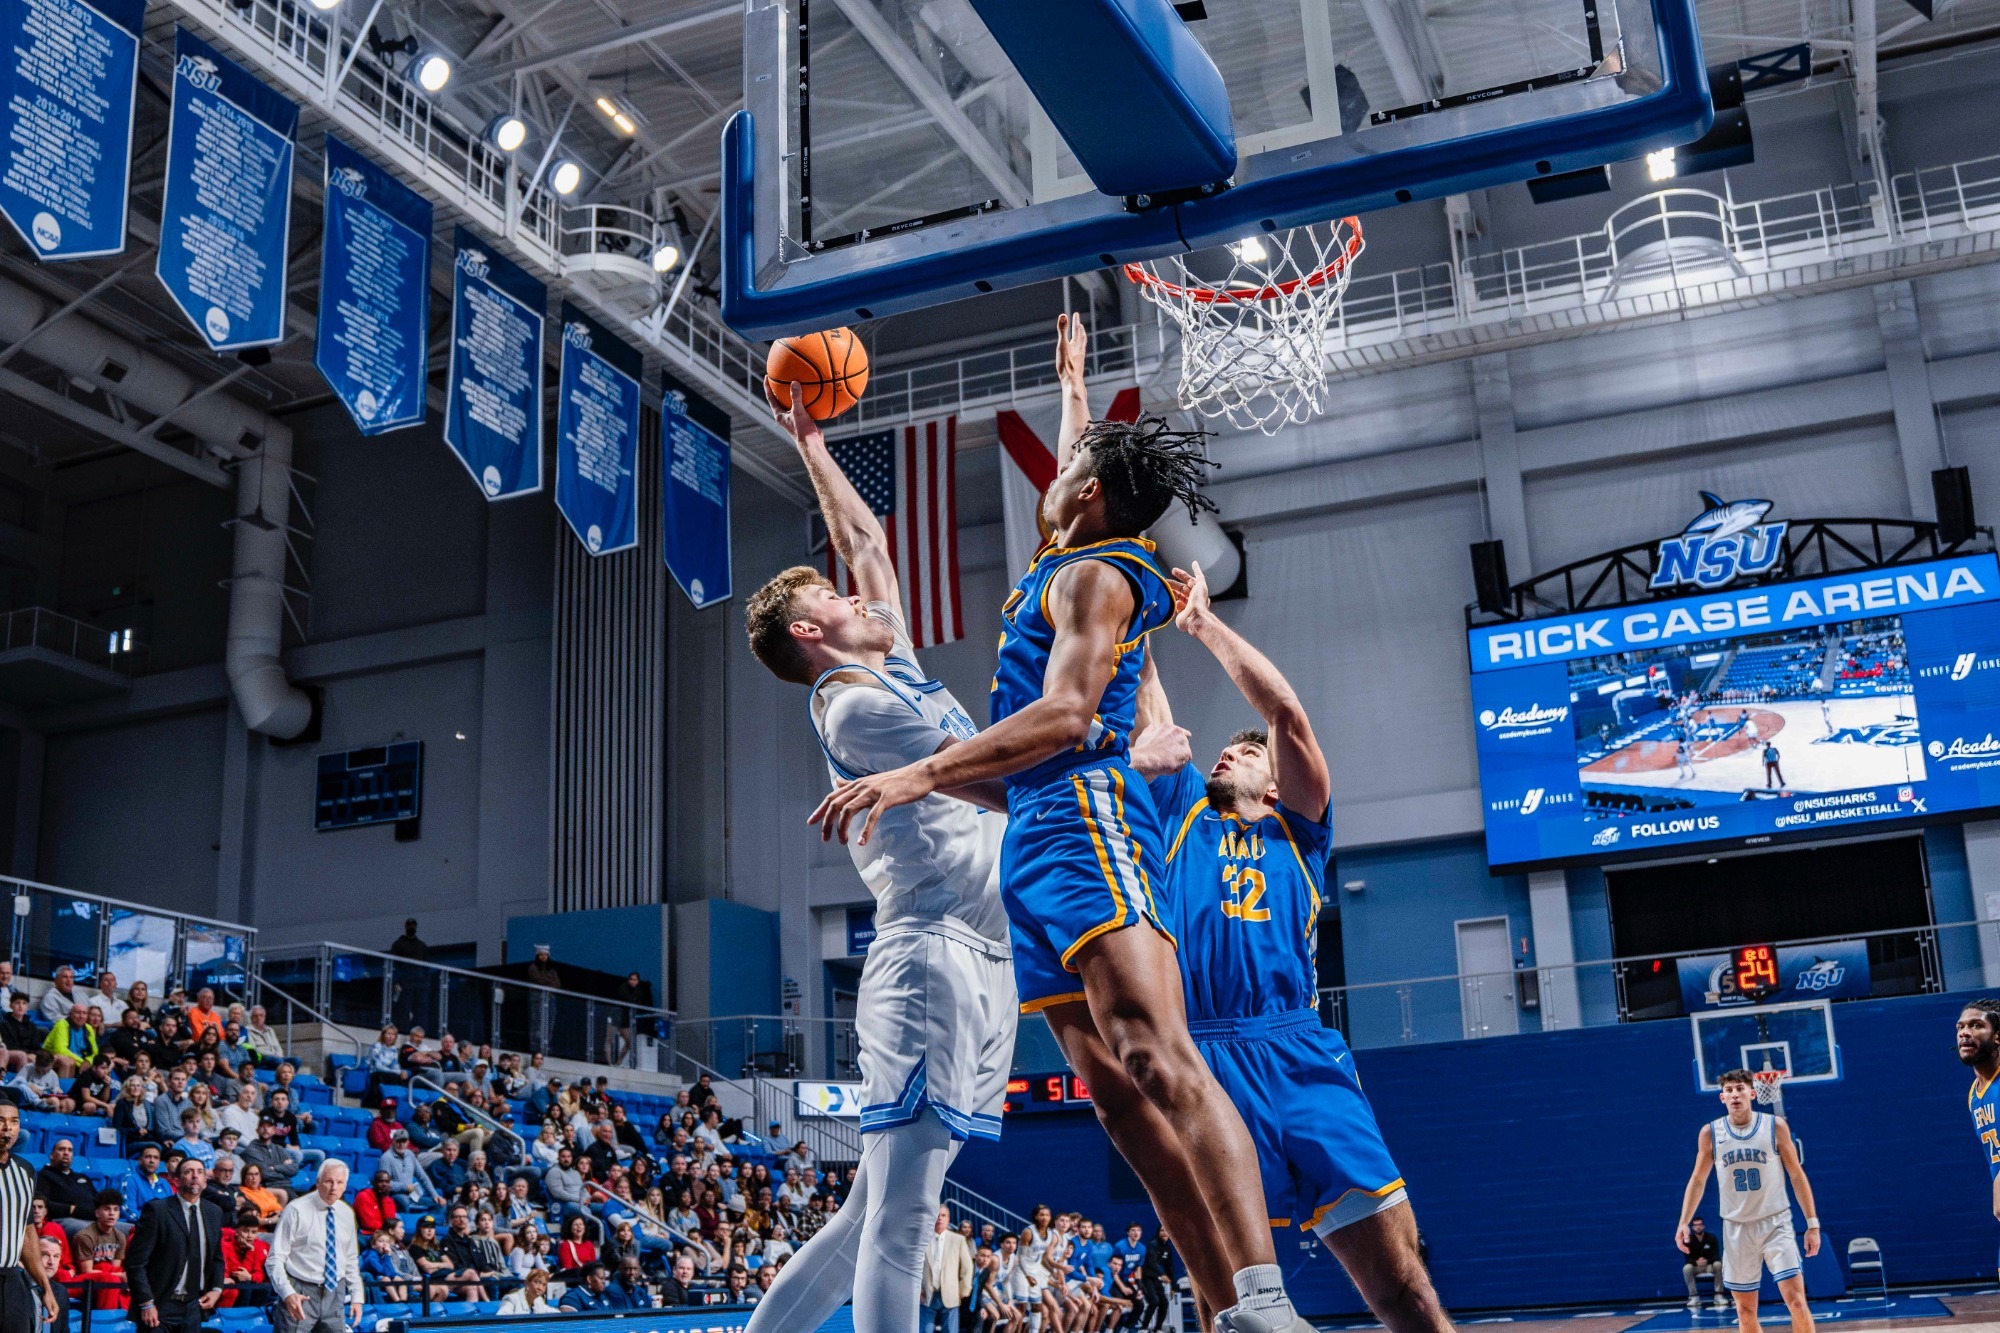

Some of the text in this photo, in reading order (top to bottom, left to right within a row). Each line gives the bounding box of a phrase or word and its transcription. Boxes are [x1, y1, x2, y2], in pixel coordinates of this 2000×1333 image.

[177, 55, 222, 93] NSU
[35, 92, 80, 131] 2013-2014
[330, 166, 367, 200] NSU
[456, 248, 490, 281] NSU
[1649, 521, 1788, 589] NSU
[1488, 566, 1986, 663] RICK CASE ARENA
[1497, 702, 1569, 726] Academy
[1499, 727, 1552, 739] academybus.com
[1544, 793, 1574, 805] JONES
[1793, 791, 1876, 812] @NSUSHARKS
[1631, 818, 1695, 838] FOLLOW
[1697, 816, 1720, 831] US
[1775, 802, 1902, 828] @NSU_MBASKETBALL
[1221, 864, 1271, 922] 32
[855, 931, 878, 939] RESTR
[1722, 975, 1735, 994] 5
[1739, 960, 1775, 989] 24
[1796, 968, 1845, 991] NSU
[1047, 1077, 1062, 1101] 5
[1722, 1147, 1767, 1168] SHARKS
[1733, 1167, 1761, 1191] 20
